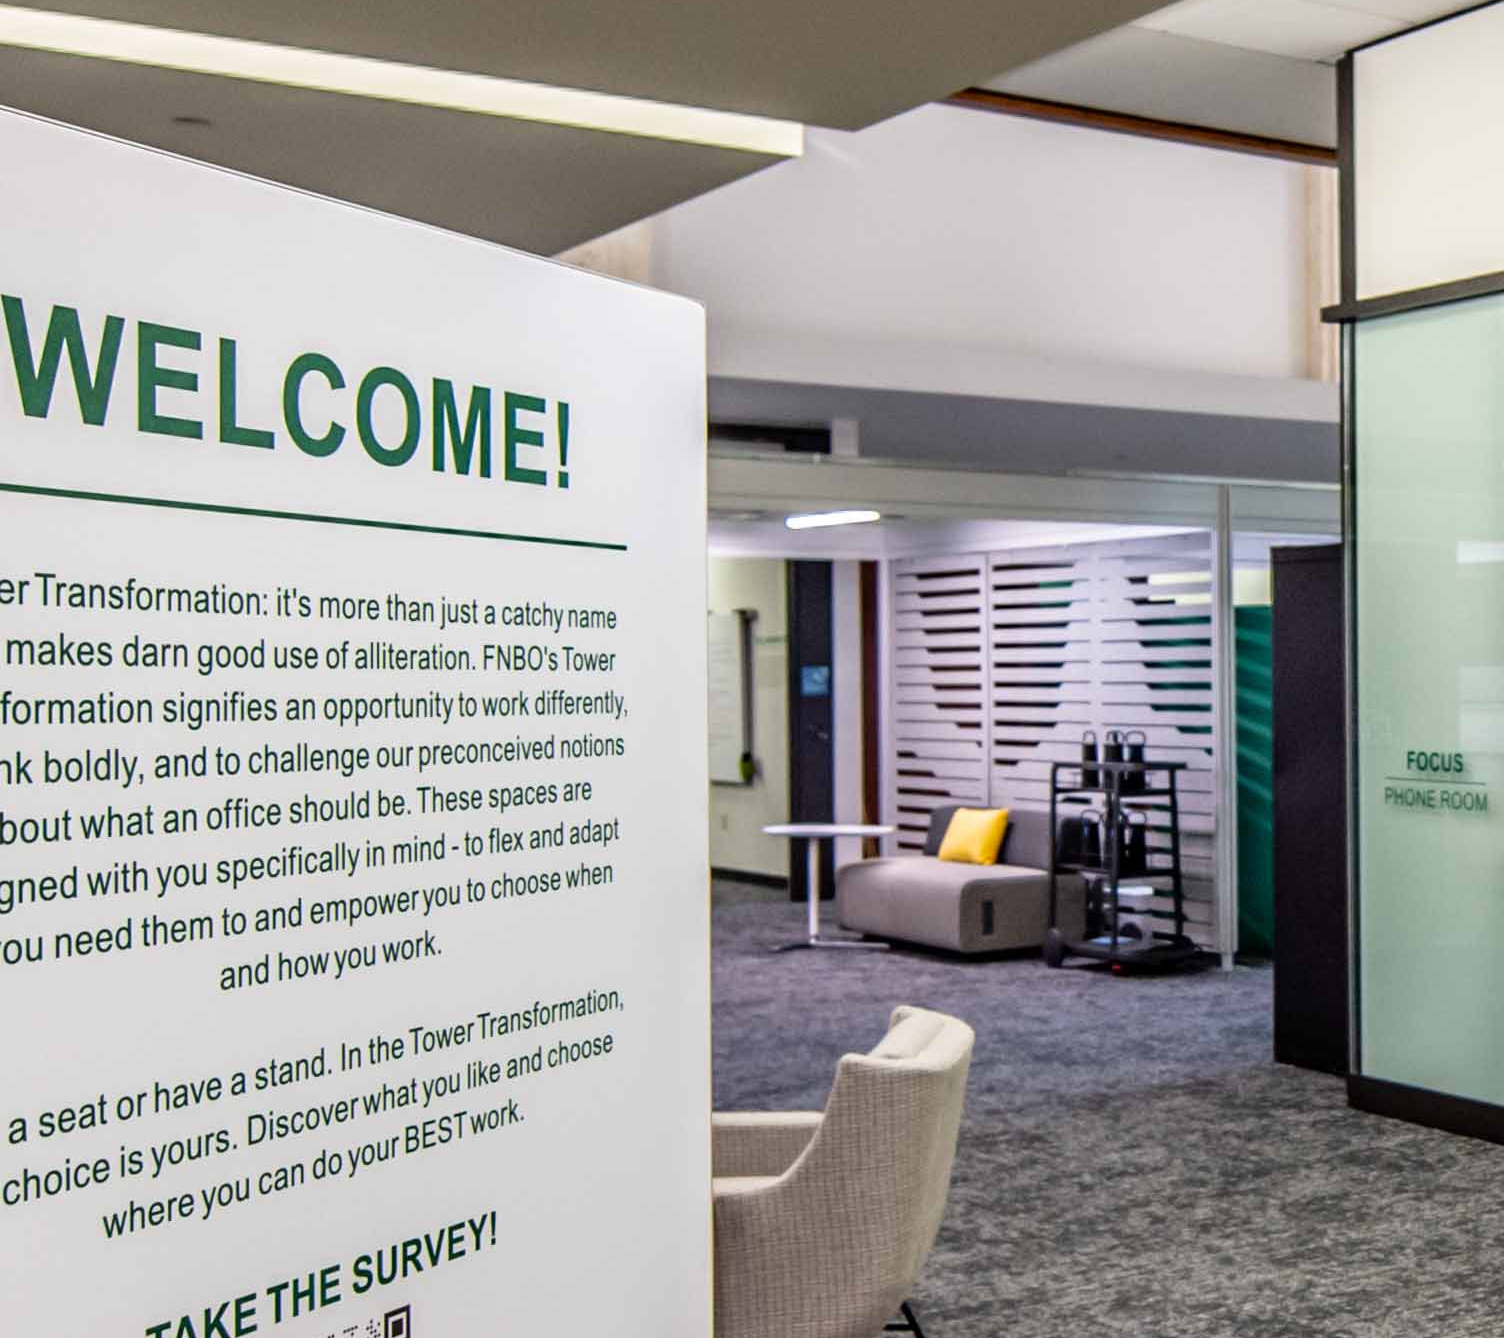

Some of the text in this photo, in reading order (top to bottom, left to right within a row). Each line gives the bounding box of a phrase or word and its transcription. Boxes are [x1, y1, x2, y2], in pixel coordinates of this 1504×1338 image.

[0, 294, 569, 489] WELCOME!
[33, 572, 269, 617] Transformation:
[276, 586, 312, 618] it's
[319, 596, 381, 621] more
[385, 592, 435, 623] than
[439, 596, 479, 631] just
[483, 604, 496, 626] a
[501, 601, 565, 635] catchy
[567, 608, 617, 630] name
[5, 631, 114, 668] makes
[121, 634, 189, 669] darn
[196, 637, 266, 677] good
[273, 646, 320, 670] use
[325, 639, 350, 670] of
[354, 640, 477, 671] alliteration.
[482, 644, 559, 672] FNBO's
[561, 645, 617, 672] Tower
[162, 690, 278, 732] signifies
[285, 697, 316, 722] an
[322, 690, 455, 728] opportunity
[457, 691, 478, 718] to
[481, 689, 530, 718] work
[533, 689, 628, 721] differently,
[43, 748, 145, 790] boldly,
[153, 744, 208, 780] and
[214, 746, 241, 777] to
[247, 741, 371, 778] challenge
[375, 745, 415, 769] our
[418, 733, 556, 774] preconceived
[559, 732, 625, 760] notions
[1406, 750, 1465, 774] FOCUS
[79, 804, 155, 840] what
[162, 808, 198, 835] an
[205, 797, 283, 831] office
[288, 789, 371, 825] should
[377, 788, 412, 818] be.
[415, 785, 484, 814] These
[487, 783, 559, 814] spaces
[562, 781, 593, 803] are
[1384, 786, 1489, 814] PHONE ROOM
[86, 860, 149, 897] with
[155, 861, 208, 899] you
[215, 841, 361, 891] specifically
[365, 839, 386, 869] in
[392, 831, 446, 865] mind
[463, 830, 484, 858] to
[487, 826, 525, 854] flex
[529, 820, 565, 851] and
[569, 817, 620, 848] adapt
[54, 916, 133, 960] need
[140, 913, 214, 948] them
[220, 906, 248, 937] to
[254, 896, 303, 933] and
[309, 889, 421, 928] empower
[421, 884, 461, 917] you
[465, 877, 486, 904] to
[490, 871, 562, 900] choose
[564, 861, 613, 890] when
[219, 929, 442, 991] and how you work.
[7, 1117, 28, 1145] a
[37, 1093, 109, 1139] seat
[116, 1091, 148, 1122] or
[153, 1076, 223, 1114] have
[230, 1071, 247, 1097] a
[254, 1046, 333, 1091] stand.
[340, 1042, 362, 1072] In
[367, 1034, 405, 1066] the
[408, 1021, 476, 1056] Tower
[476, 988, 624, 1040] Transformation,
[2, 1157, 111, 1206] choice
[119, 1144, 144, 1179] is
[150, 1128, 238, 1180] yours.
[247, 1096, 360, 1147] Discover
[361, 1077, 419, 1117] what
[421, 1071, 461, 1109] you
[466, 1060, 502, 1090] like
[506, 1044, 543, 1080] and
[547, 1034, 614, 1069] choose
[101, 1097, 525, 1239] where you can do your BEST work.
[265, 1263, 342, 1325] THE
[351, 1210, 497, 1295] SURVEY!
